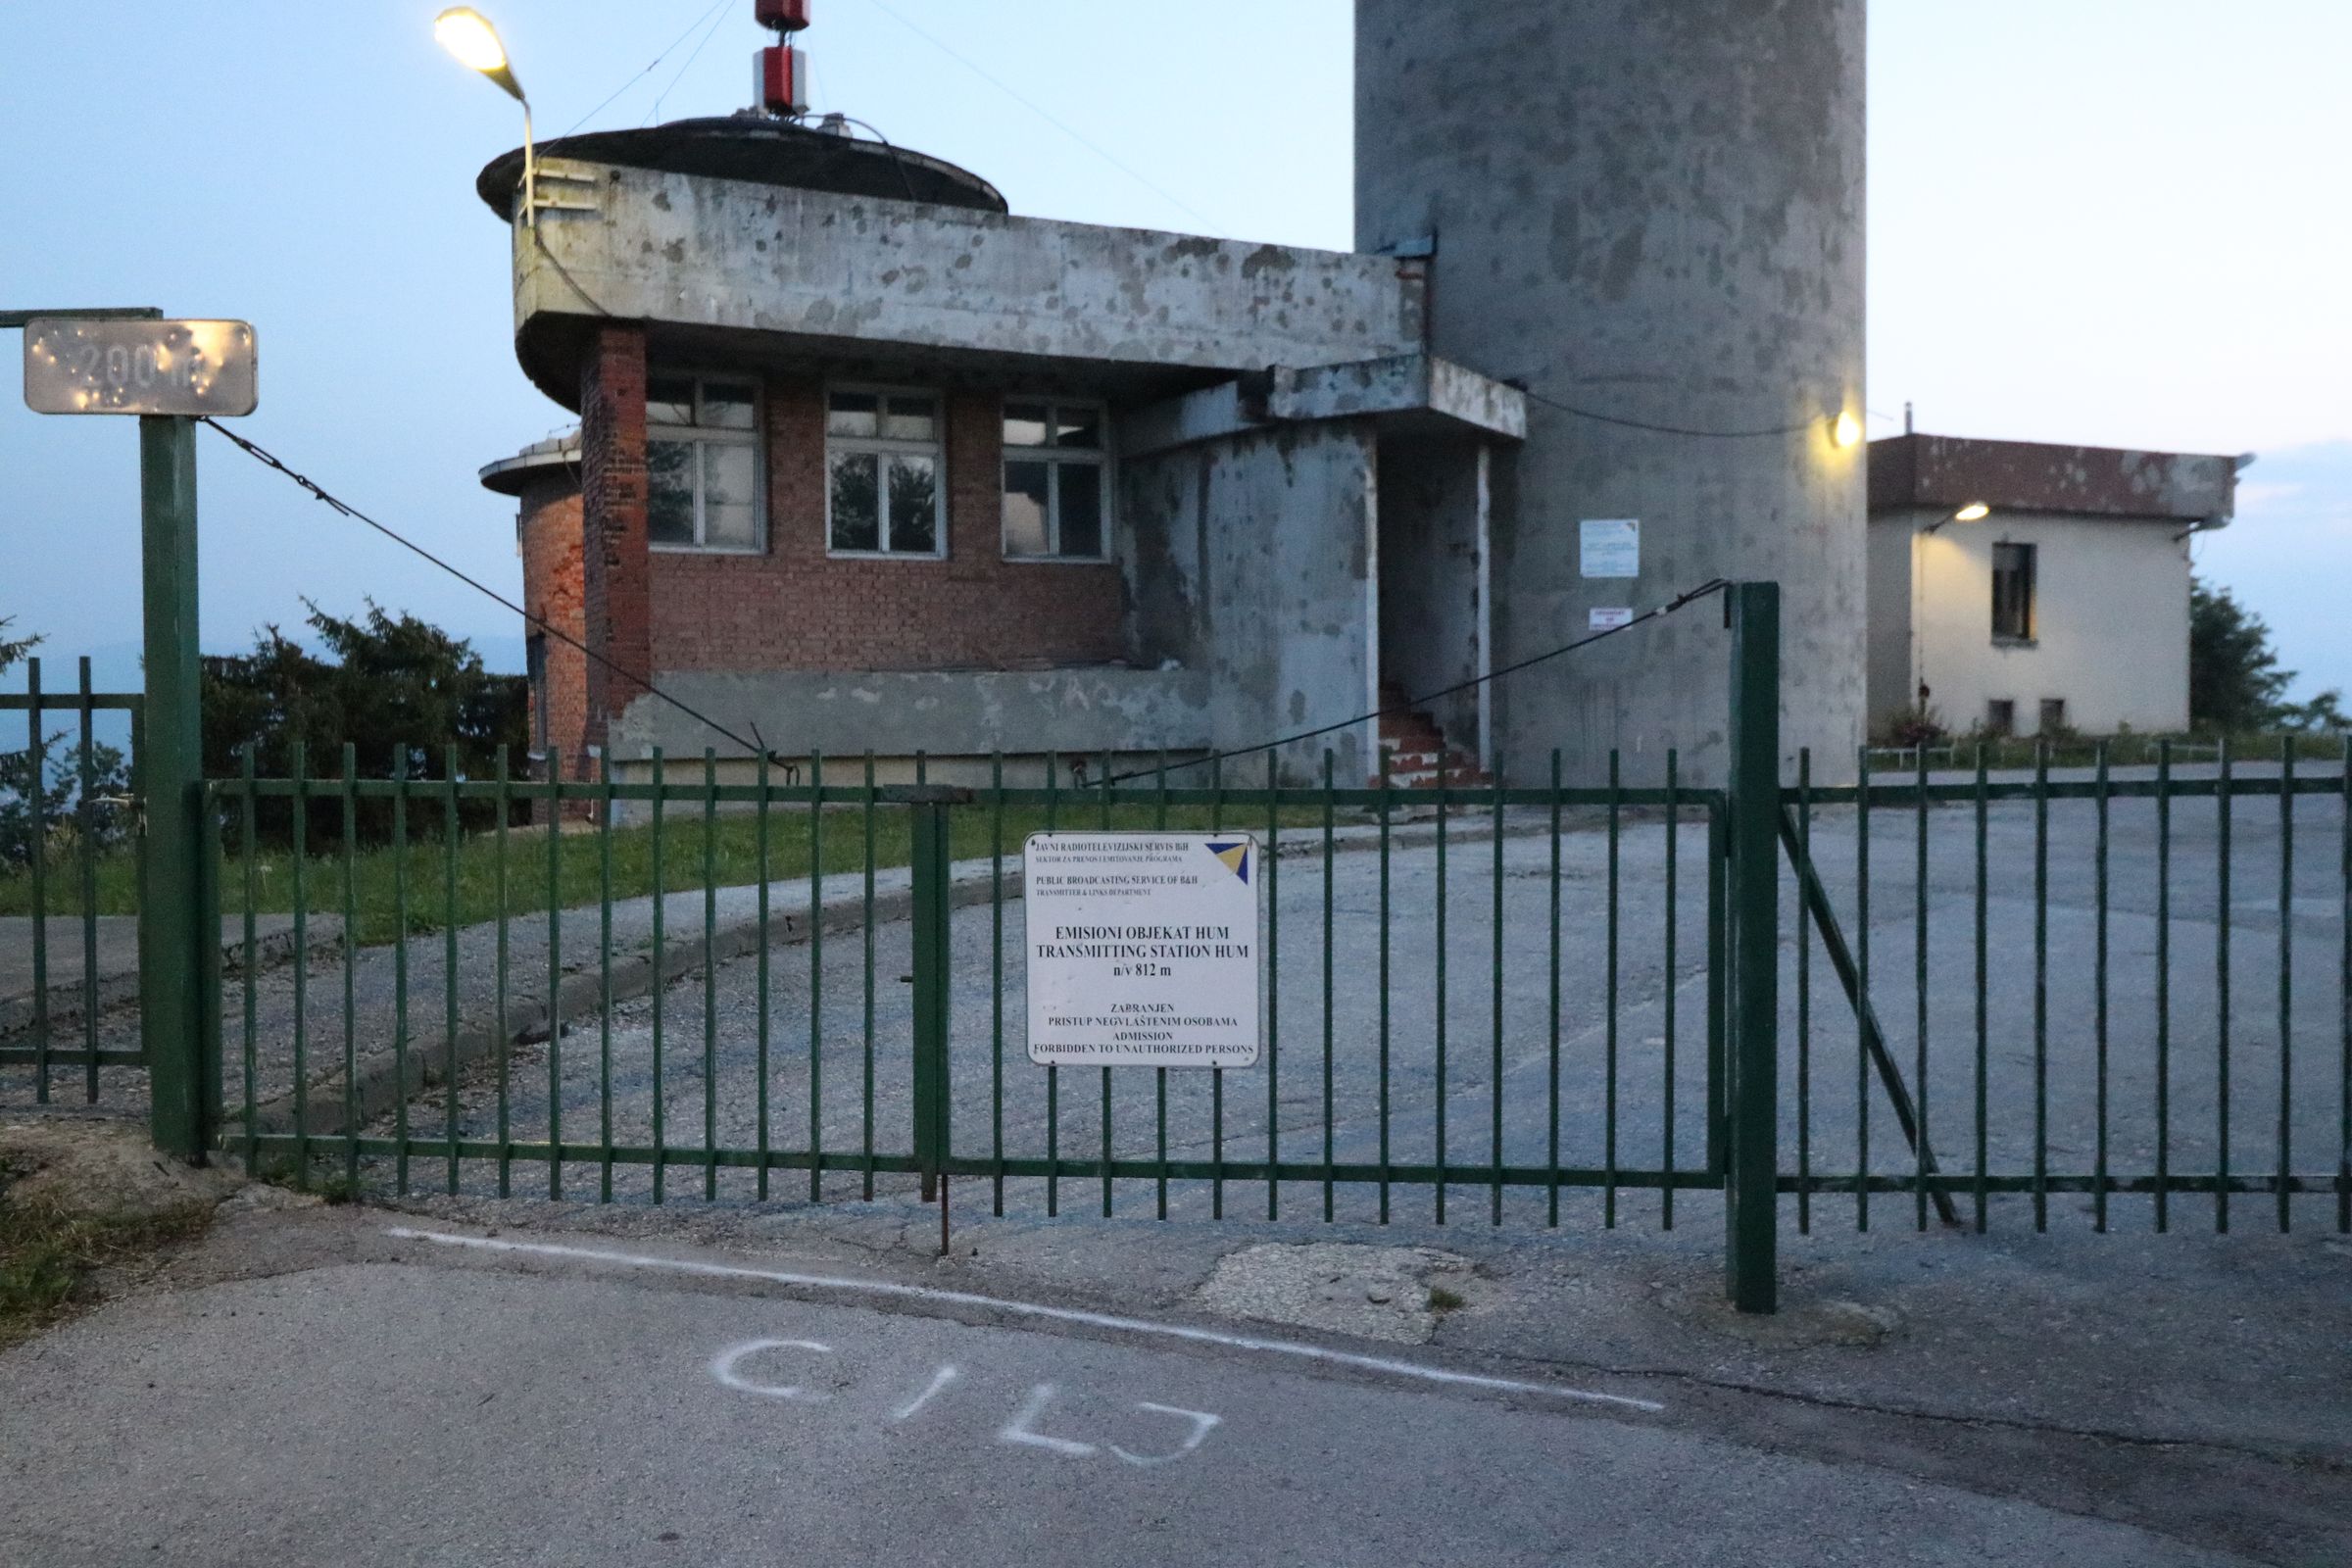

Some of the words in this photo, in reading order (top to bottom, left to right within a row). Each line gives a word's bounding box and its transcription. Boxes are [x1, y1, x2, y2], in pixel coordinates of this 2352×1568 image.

[78, 344, 157, 389] 200
[1036, 843, 1059, 852] JAVNI
[1060, 843, 1144, 852] RADIOTELEVIZIJSKI
[1145, 843, 1173, 852] SERVIS
[1067, 876, 1130, 885] BROADCASTING
[1131, 876, 1166, 885] SERVICE
[1167, 876, 1178, 885] OF
[1055, 926, 1122, 940] EMISIONI
[1126, 926, 1192, 940] OBJEKAT
[1196, 926, 1229, 940] HUM
[1036, 945, 1147, 957] TRANSMITTING
[1150, 945, 1210, 957] STATION
[1215, 945, 1249, 957] HUM
[1113, 963, 1133, 976] n/v
[1135, 963, 1156, 976] 812
[1159, 966, 1172, 976] m
[1110, 1004, 1175, 1013] ZABRANJEN
[1049, 1017, 1093, 1026] PRISTUP
[1183, 1016, 1238, 1026] OSOBAMA
[1112, 1032, 1174, 1041] ADMISSION
[1034, 1044, 1096, 1054] FORBIDDEN
[1100, 1044, 1113, 1054] TO
[1116, 1044, 1202, 1054] UNAUTHORIZED
[1205, 1044, 1254, 1054] PERSONS
